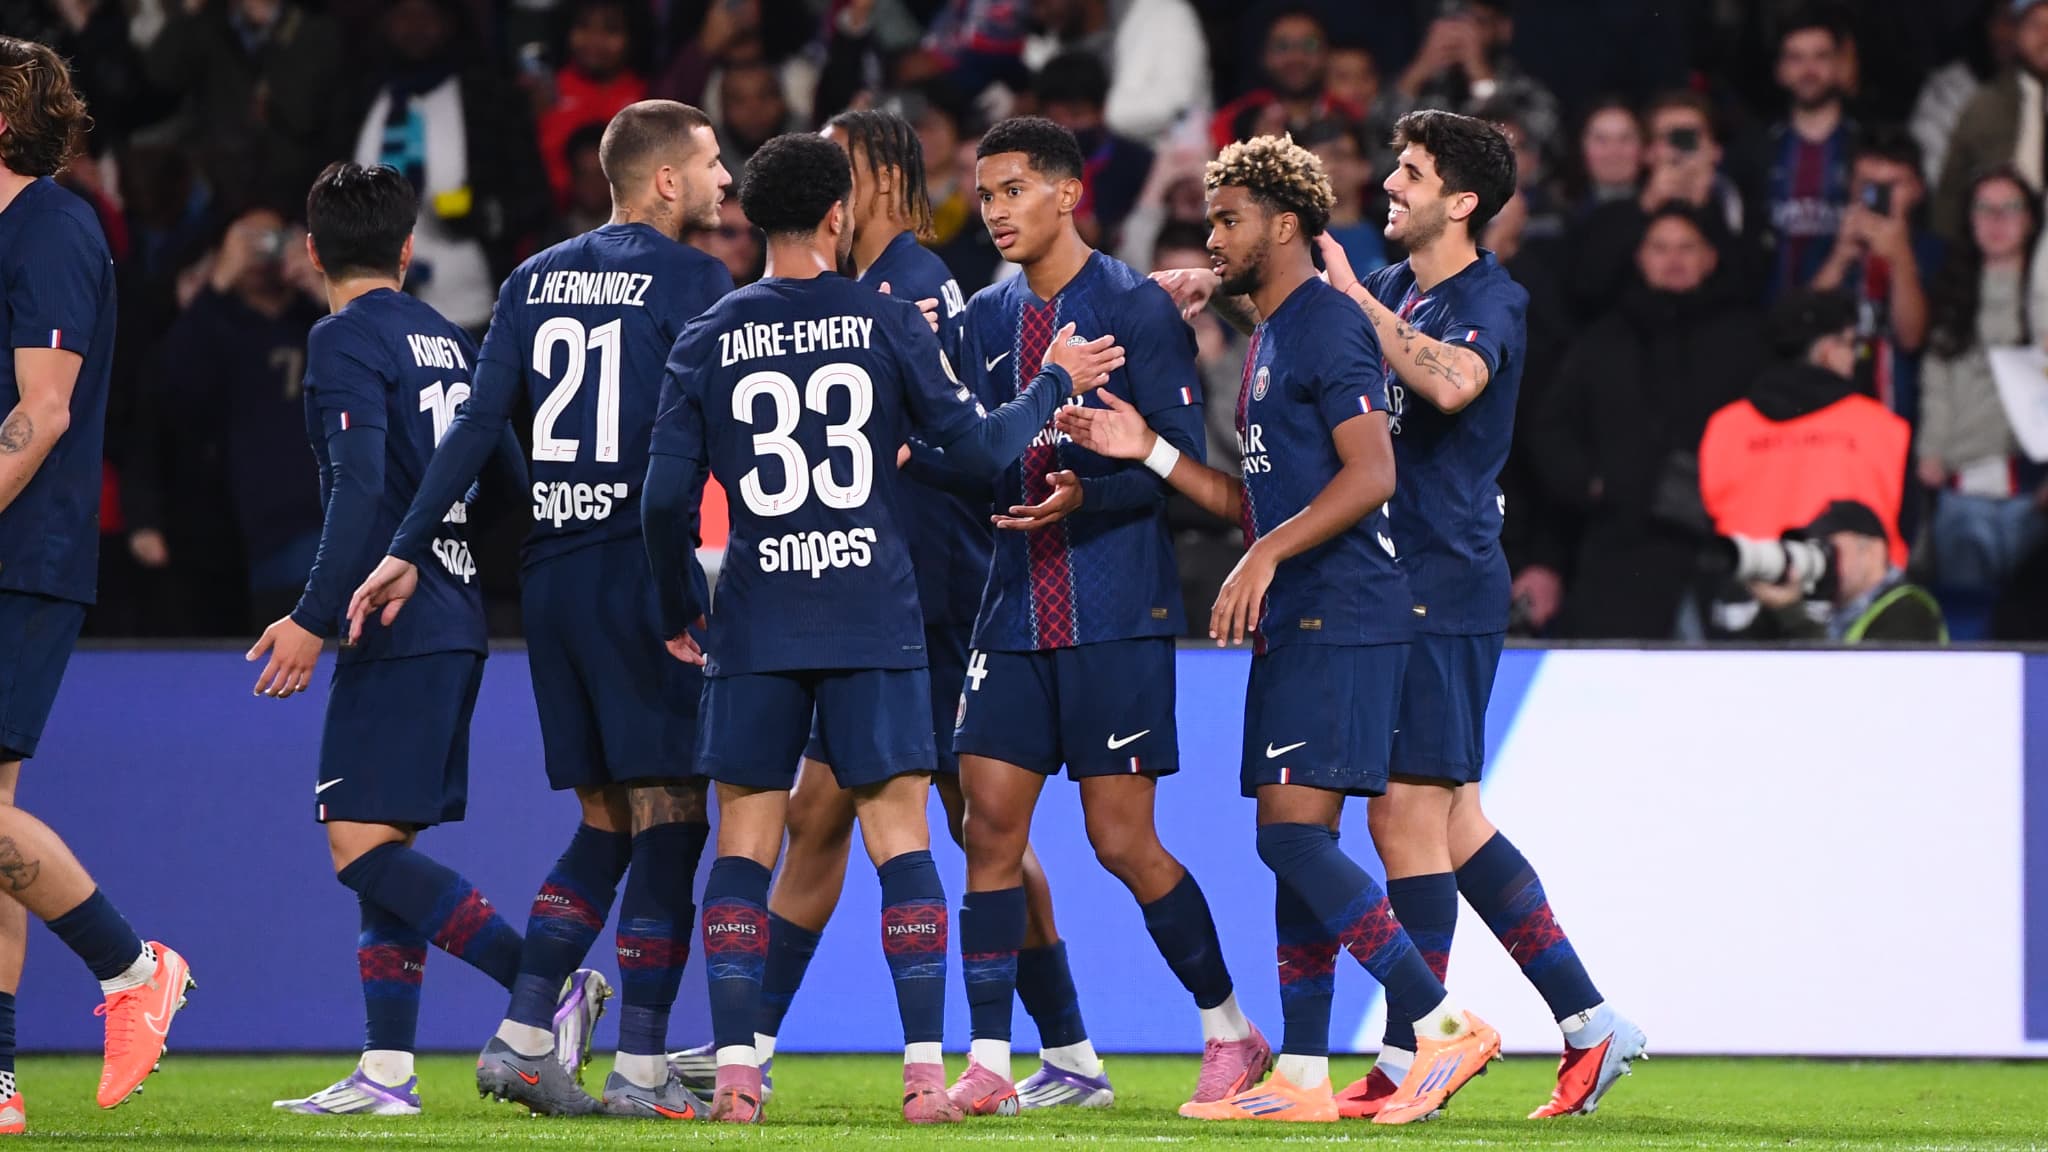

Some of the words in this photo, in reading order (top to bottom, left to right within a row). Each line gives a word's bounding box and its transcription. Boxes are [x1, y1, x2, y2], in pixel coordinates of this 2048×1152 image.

[526, 271, 652, 306] L.HERNANDEZ
[714, 315, 873, 367] ZAÏRE-EMERY
[532, 316, 621, 463] 21
[732, 362, 873, 517] 33
[759, 530, 873, 579] snipes
[708, 923, 756, 935] PARIS
[887, 923, 937, 936] PARIS
